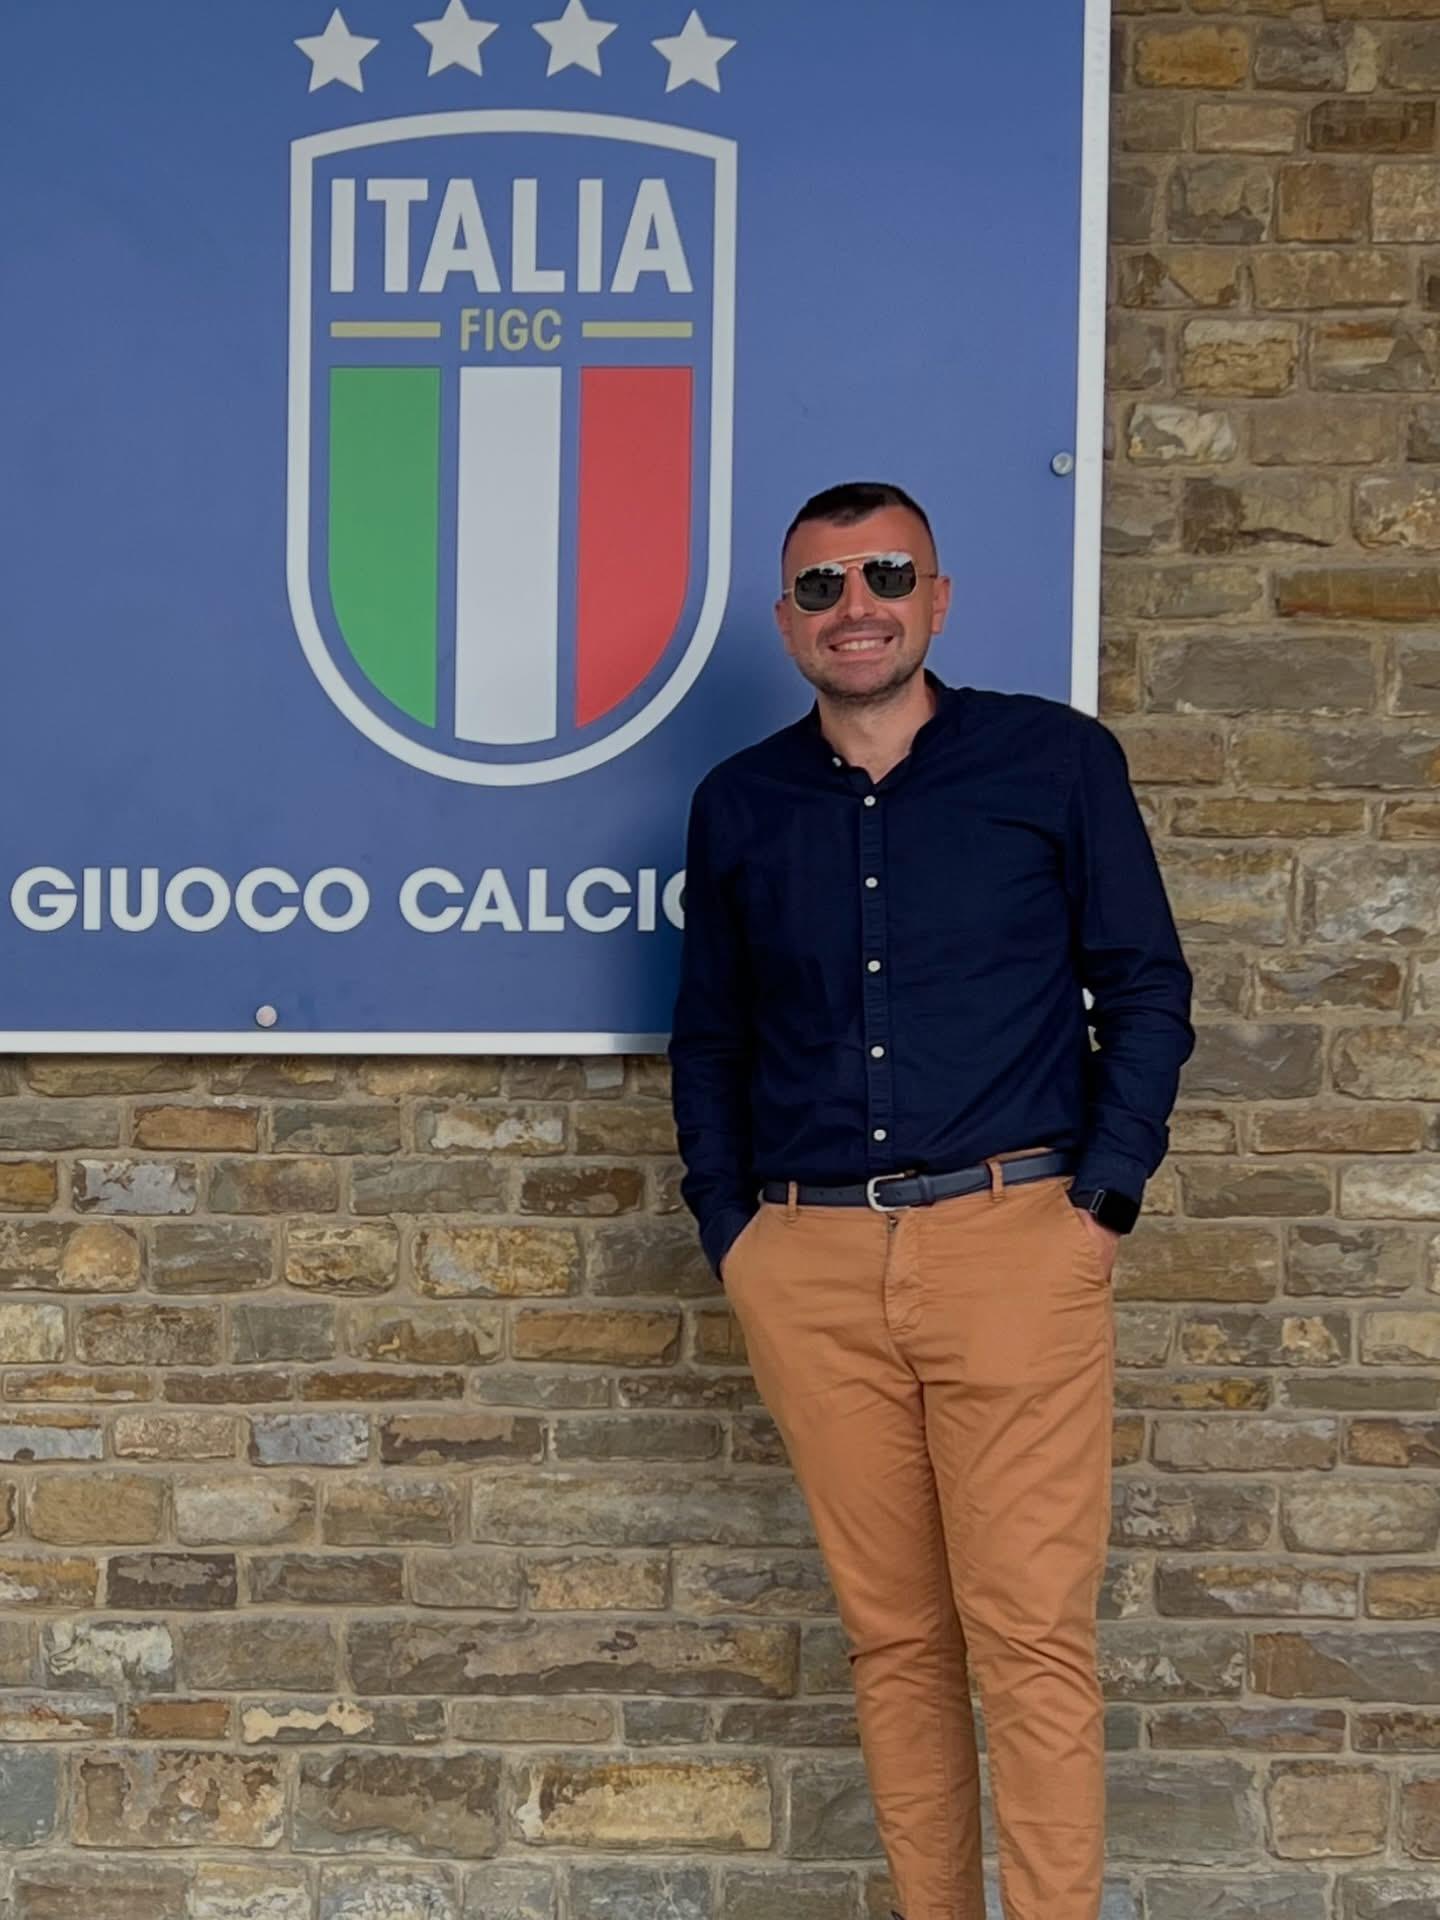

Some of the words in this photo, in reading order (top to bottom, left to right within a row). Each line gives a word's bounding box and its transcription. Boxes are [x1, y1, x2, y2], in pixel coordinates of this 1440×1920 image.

[329, 178, 694, 293] ITALIA
[460, 308, 562, 351] FIGC
[11, 866, 370, 932] GIUOCO
